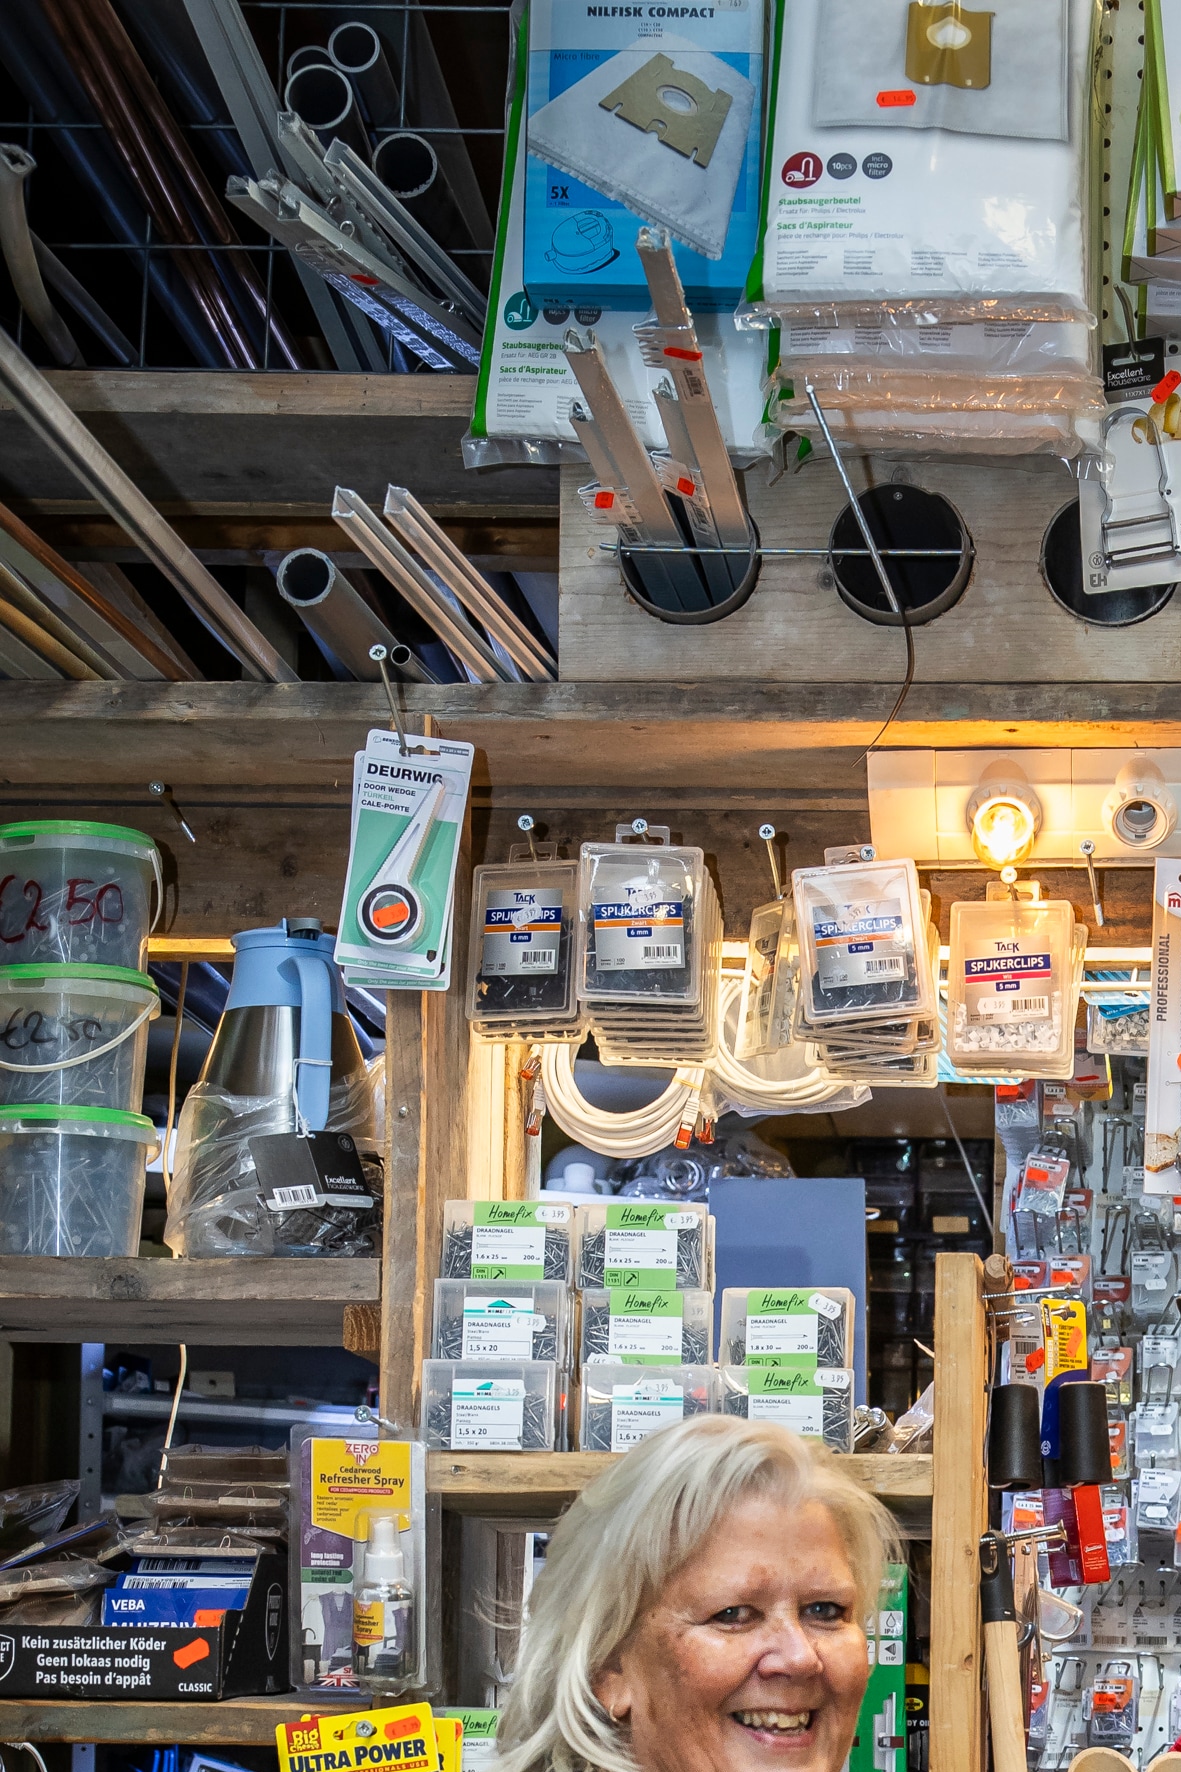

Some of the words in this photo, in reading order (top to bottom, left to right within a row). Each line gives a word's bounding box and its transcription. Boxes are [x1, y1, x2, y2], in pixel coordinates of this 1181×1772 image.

[587, 6, 643, 18] NILFISK
[648, 7, 716, 19] COMPACT
[553, 52, 577, 61] Micro
[832, 161, 853, 171] 10pcs
[868, 168, 886, 177] filter
[550, 186, 569, 200] 5X
[778, 196, 861, 207] Staubsaugerbeutel
[499, 365, 517, 374] Sacs
[518, 365, 568, 375] d'Aspirateur
[1106, 367, 1144, 381] Excellent
[1107, 374, 1152, 387] houseware
[362, 790, 395, 802] TÜRKEIL
[363, 782, 387, 793] DOOR
[387, 786, 417, 798] WEDGE
[361, 799, 410, 814] CALE-PORTE
[513, 892, 536, 905] TACK
[600, 904, 677, 917] SPIJKERCLIPS
[820, 918, 897, 936] SPIJKERCLIPS
[970, 956, 1044, 972] SPIJKERCLIPS
[1156, 933, 1171, 1023] PROFESSIONAL
[487, 1205, 533, 1224] Homefix
[619, 1207, 665, 1227] Homefix
[467, 1321, 511, 1329] DRAADNAGELS
[345, 1443, 380, 1456] ZERO
[339, 1465, 382, 1475] Cedarwood
[320, 1473, 371, 1486] Refresher
[373, 1474, 405, 1488] Spray
[111, 1599, 146, 1611] VEBA
[21, 1635, 50, 1650] Kein
[52, 1635, 128, 1651] zusätzlicher
[129, 1636, 167, 1651] Köder
[36, 1653, 68, 1667] Geen
[71, 1653, 112, 1668] lokaas
[114, 1654, 151, 1672] nodig
[35, 1671, 57, 1685] Pas
[59, 1671, 101, 1685] besoin
[103, 1671, 152, 1689] d'appât
[178, 1682, 213, 1693] CLASSIC
[291, 1728, 319, 1745] Big
[354, 1738, 427, 1766] POWER
[409, 1760, 427, 1769] USE
